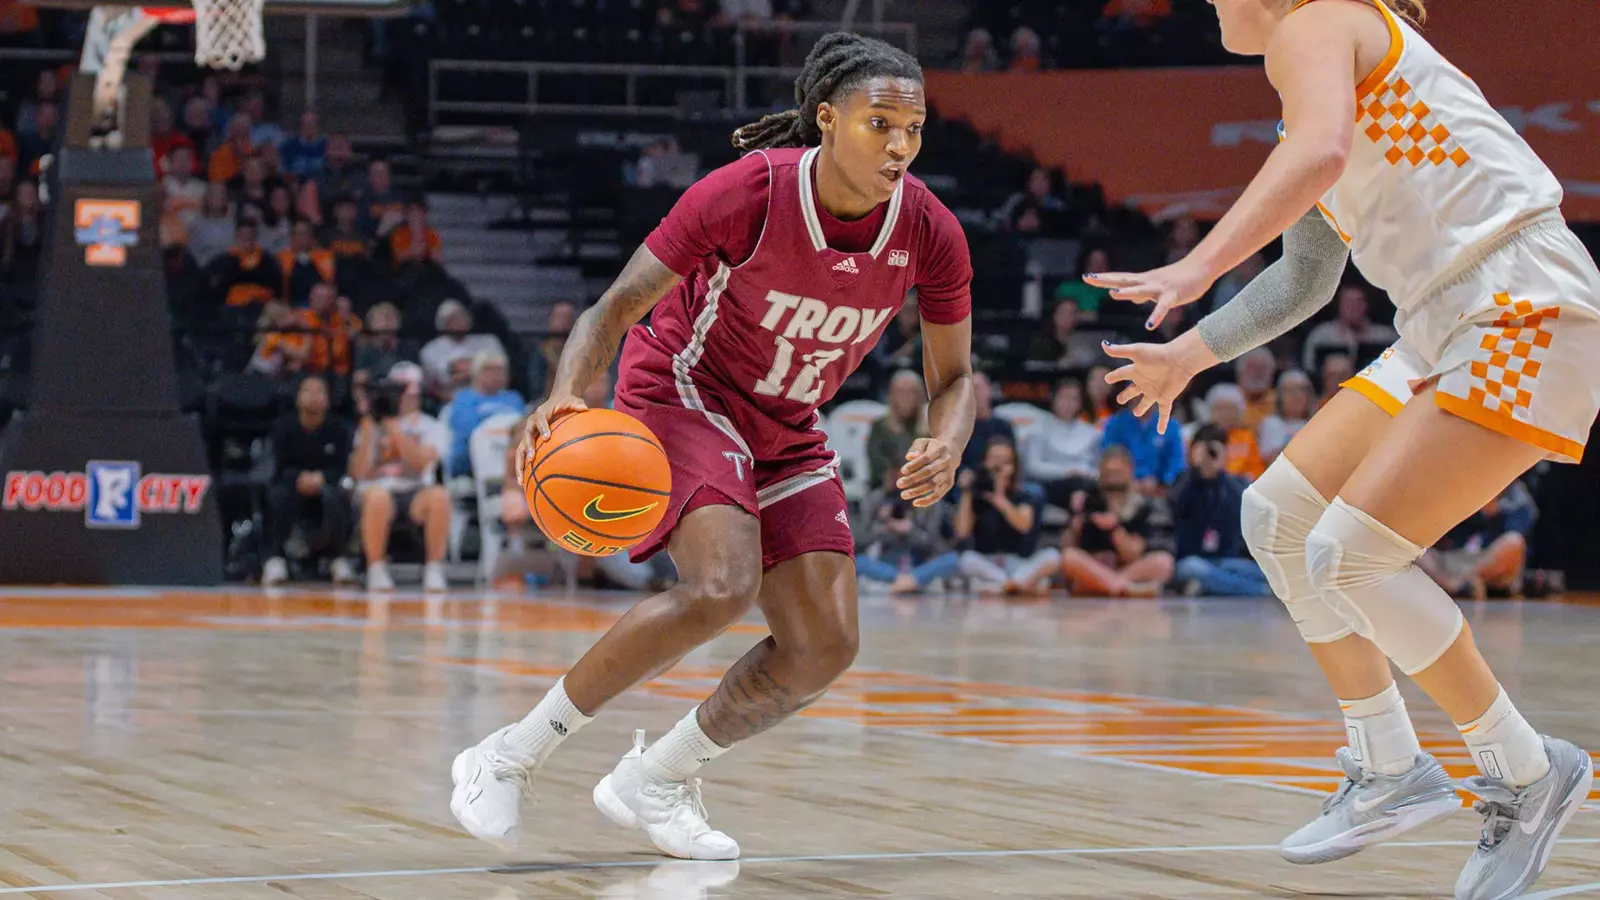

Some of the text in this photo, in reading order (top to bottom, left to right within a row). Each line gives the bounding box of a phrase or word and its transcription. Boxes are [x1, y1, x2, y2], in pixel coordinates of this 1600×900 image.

[759, 289, 893, 346] TROY
[753, 335, 845, 405] 12
[4, 472, 87, 510] FOOD
[137, 474, 210, 513] CITY
